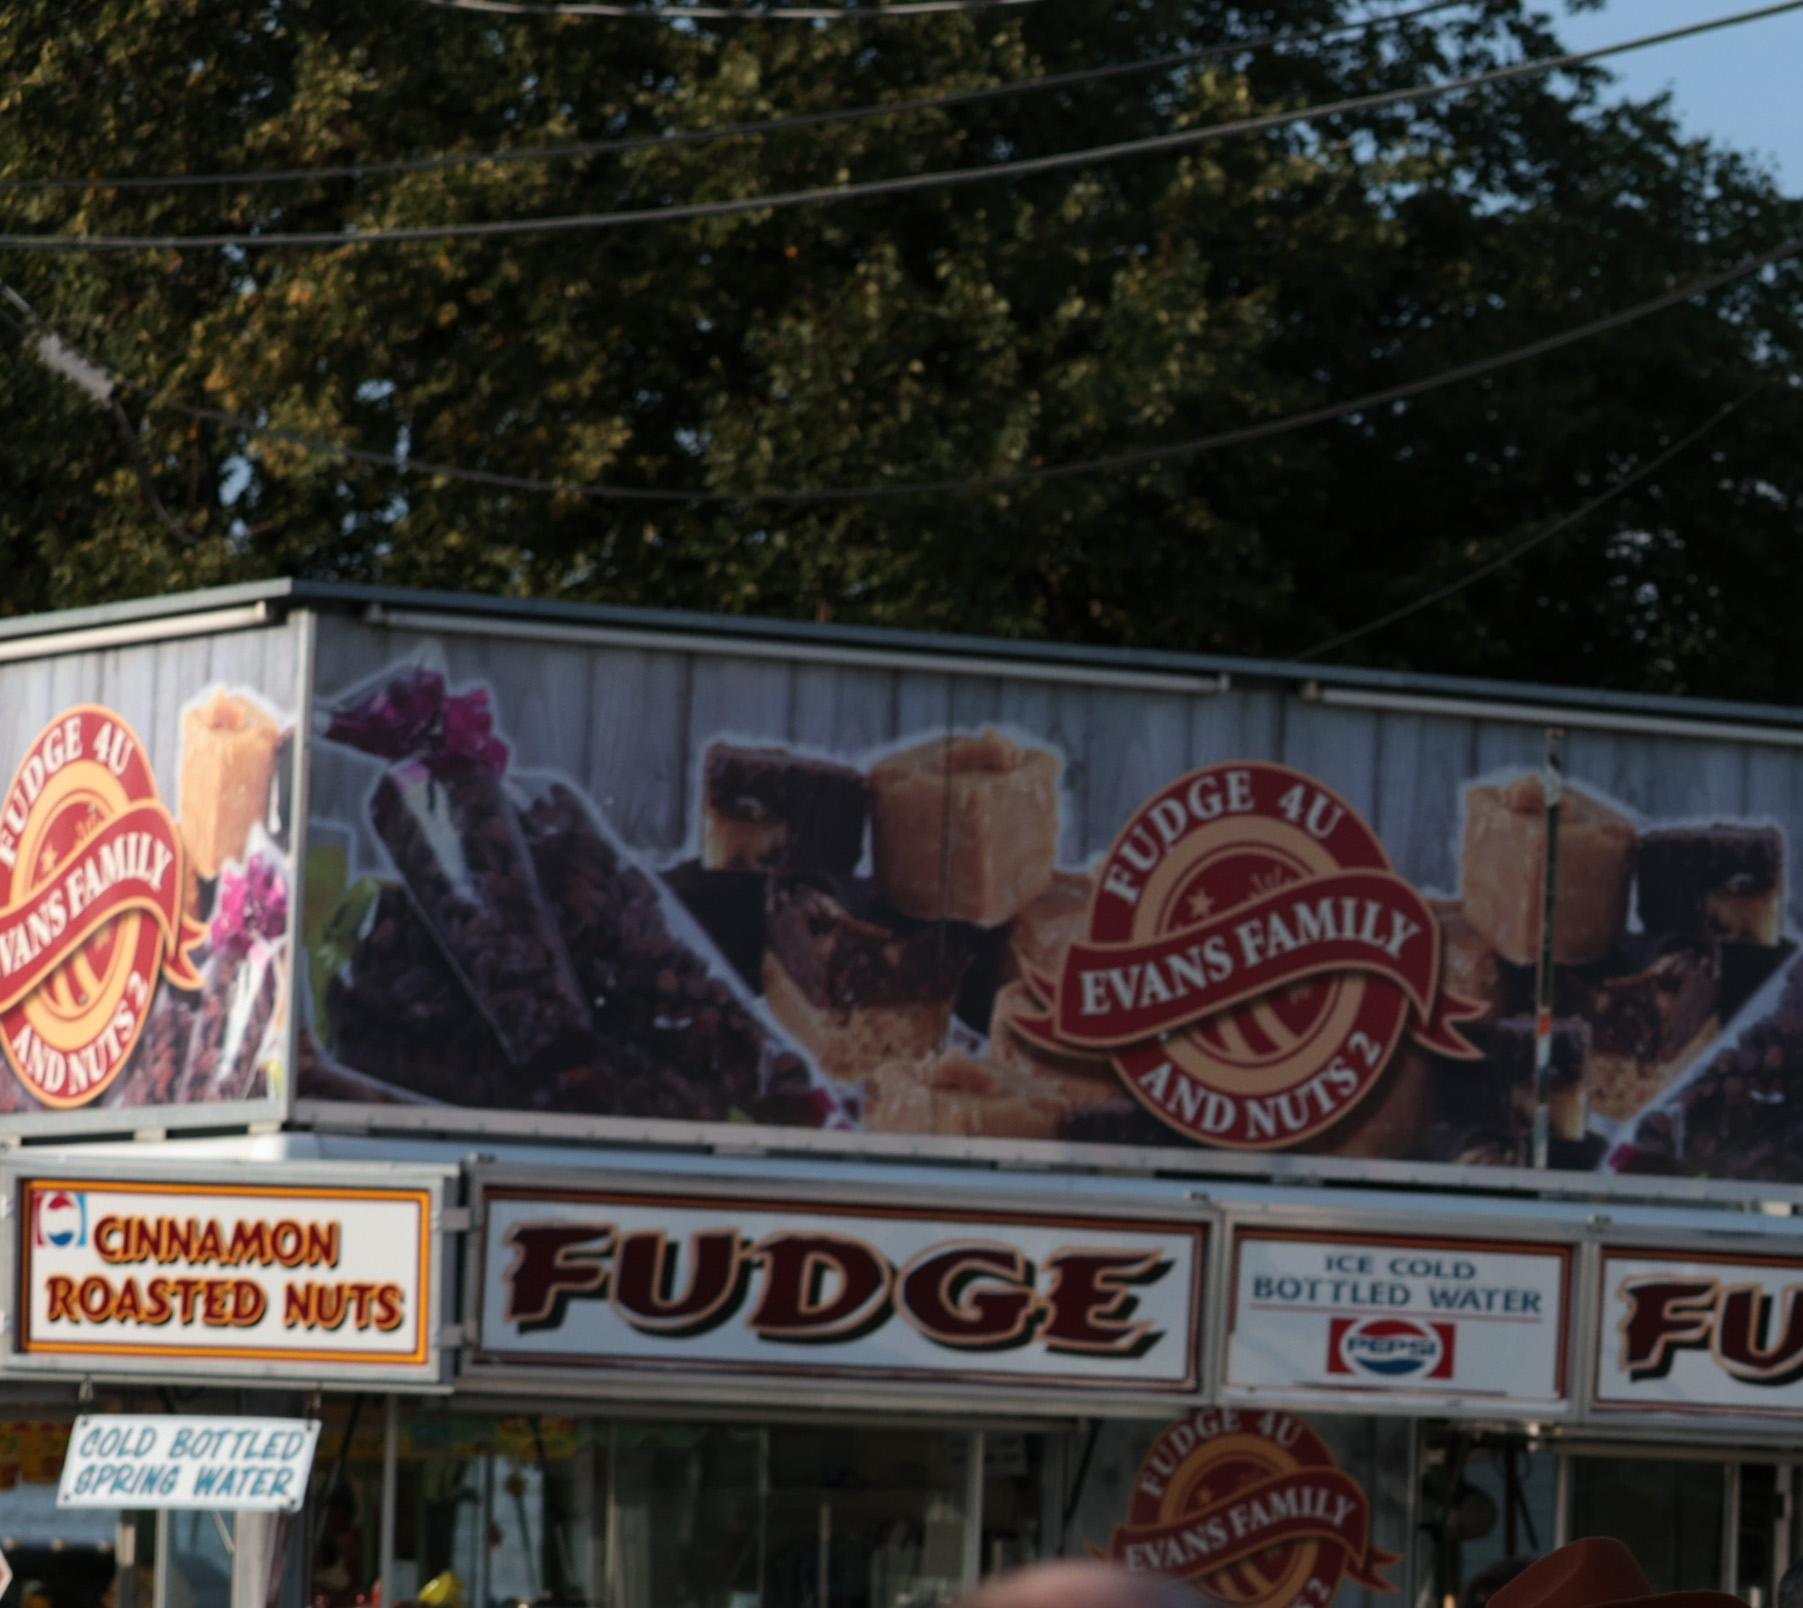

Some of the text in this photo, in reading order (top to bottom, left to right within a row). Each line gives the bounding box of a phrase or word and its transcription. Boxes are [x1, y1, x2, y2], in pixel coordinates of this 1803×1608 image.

[92, 721, 135, 777] 4U
[1104, 770, 1344, 905] FUDGE 4U
[0, 831, 175, 978] VANS FAMILY
[1078, 897, 1421, 1015] EVANS FAMILY
[12, 1023, 66, 1094] AND
[67, 1002, 137, 1096] NUTS
[1139, 1031, 1381, 1138] AND NUTS 2
[94, 1212, 340, 1268] CINNAMON
[1325, 1254, 1477, 1280] ICE COLD
[46, 1274, 405, 1332] ROASTED NUTS
[504, 1217, 1175, 1359] FUDGE
[1253, 1275, 1543, 1315] BOTTLED WATER
[1346, 1335, 1437, 1358] PEPSI
[79, 1425, 305, 1461] COLD BOTTLED
[1140, 1407, 1304, 1498] FUDGE 4U
[74, 1464, 296, 1498] SPRING WATER
[1125, 1485, 1356, 1572] EVANS FAMILY
